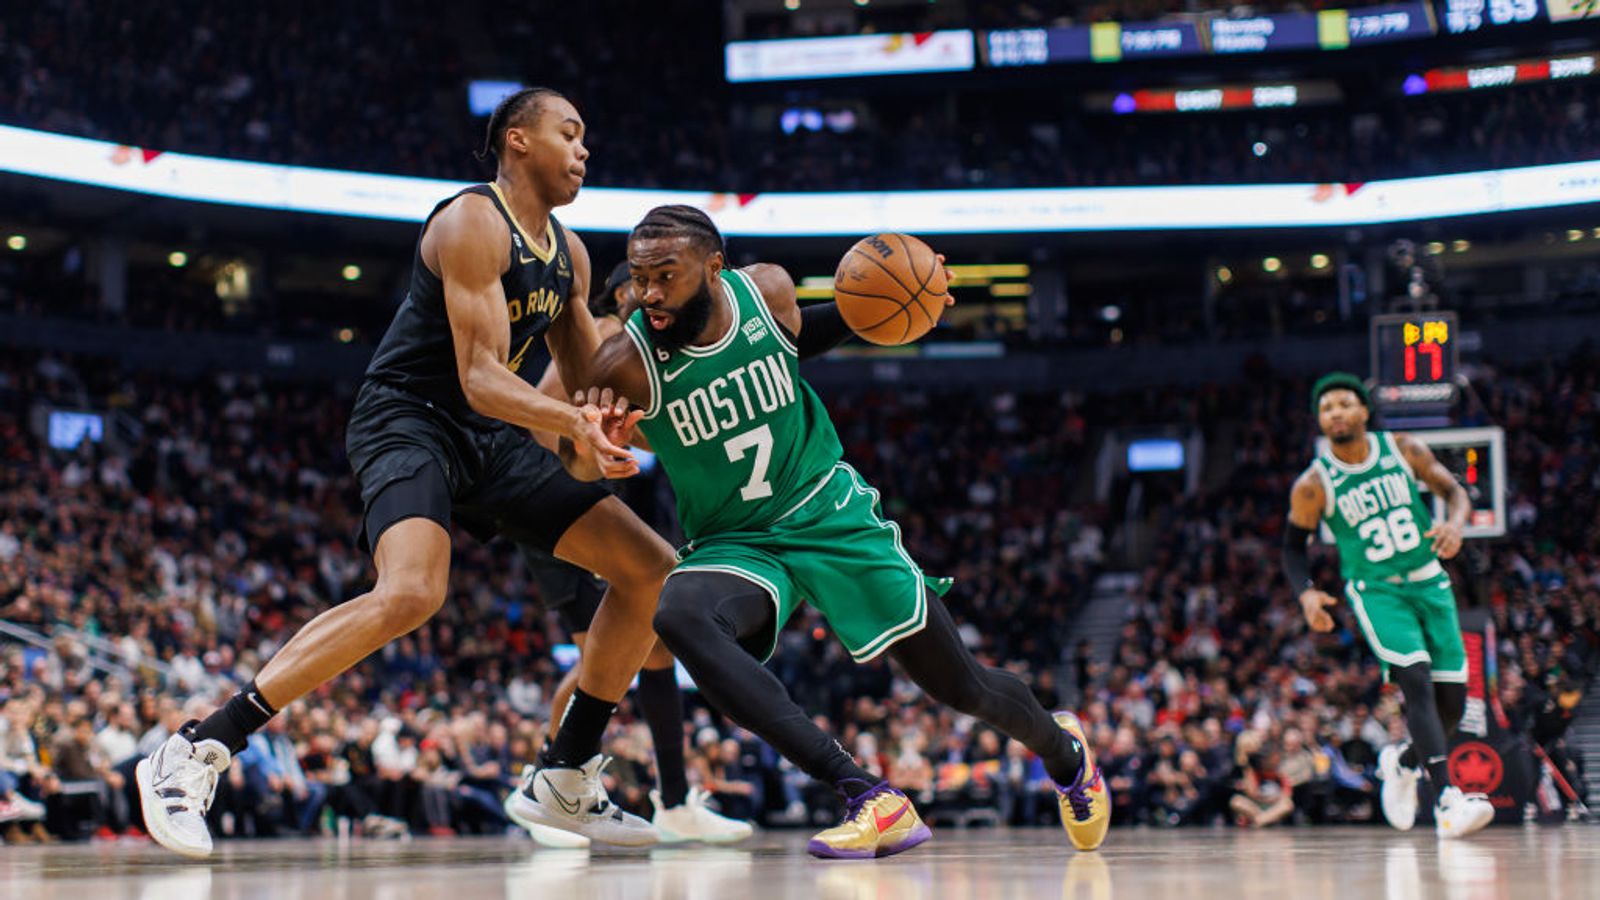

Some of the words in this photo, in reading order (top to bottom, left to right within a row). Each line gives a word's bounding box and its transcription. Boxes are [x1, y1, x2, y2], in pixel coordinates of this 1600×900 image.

[740, 315, 766, 337] VISTA
[746, 326, 768, 345] PRINT
[666, 351, 795, 447] BOSTON
[723, 423, 774, 502] 7
[1337, 472, 1412, 528] BOSTON
[1358, 506, 1421, 563] 36
